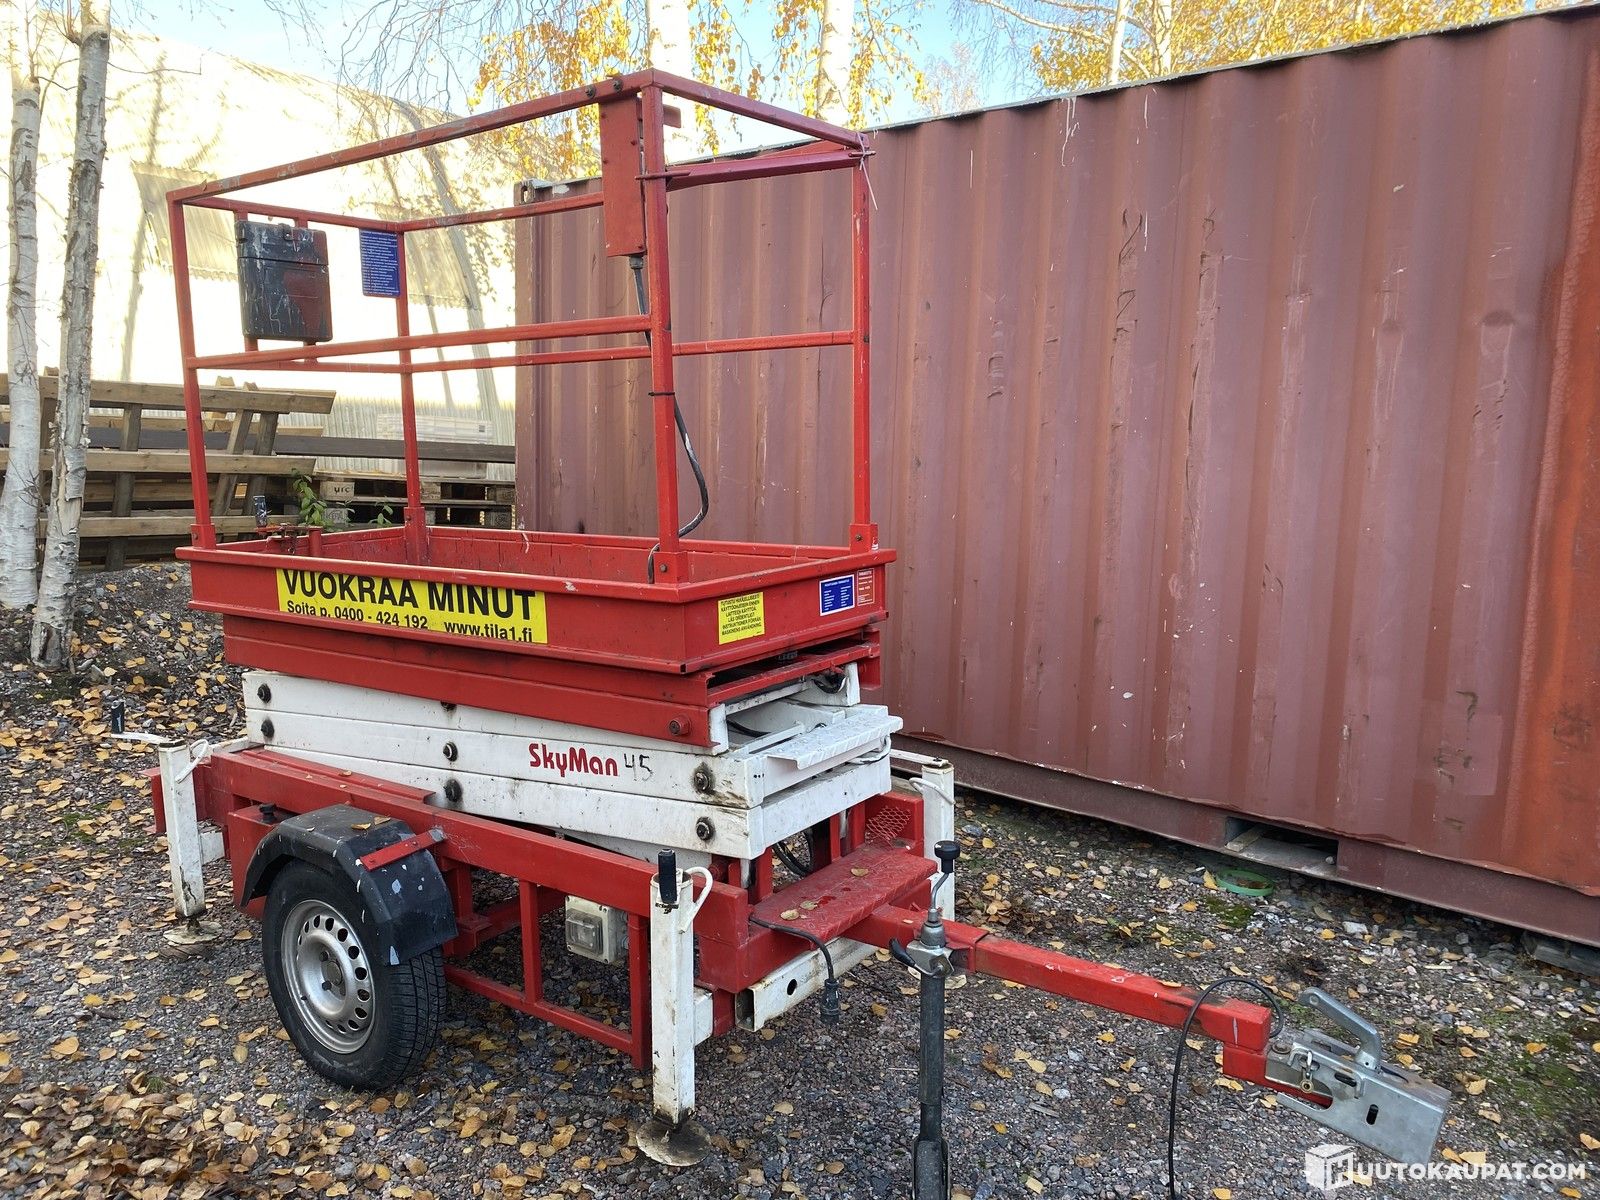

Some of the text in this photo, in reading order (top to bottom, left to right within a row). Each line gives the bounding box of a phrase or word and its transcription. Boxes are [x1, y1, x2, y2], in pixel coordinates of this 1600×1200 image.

[283, 569, 536, 620] VUOKRAA MINUT
[287, 600, 316, 617] Soita
[334, 606, 364, 622] 0400
[376, 611, 400, 626] 424
[404, 614, 428, 630] 192
[444, 621, 533, 642] www.tila1.fi
[528, 743, 618, 777] SkyMan
[624, 753, 654, 781] 45
